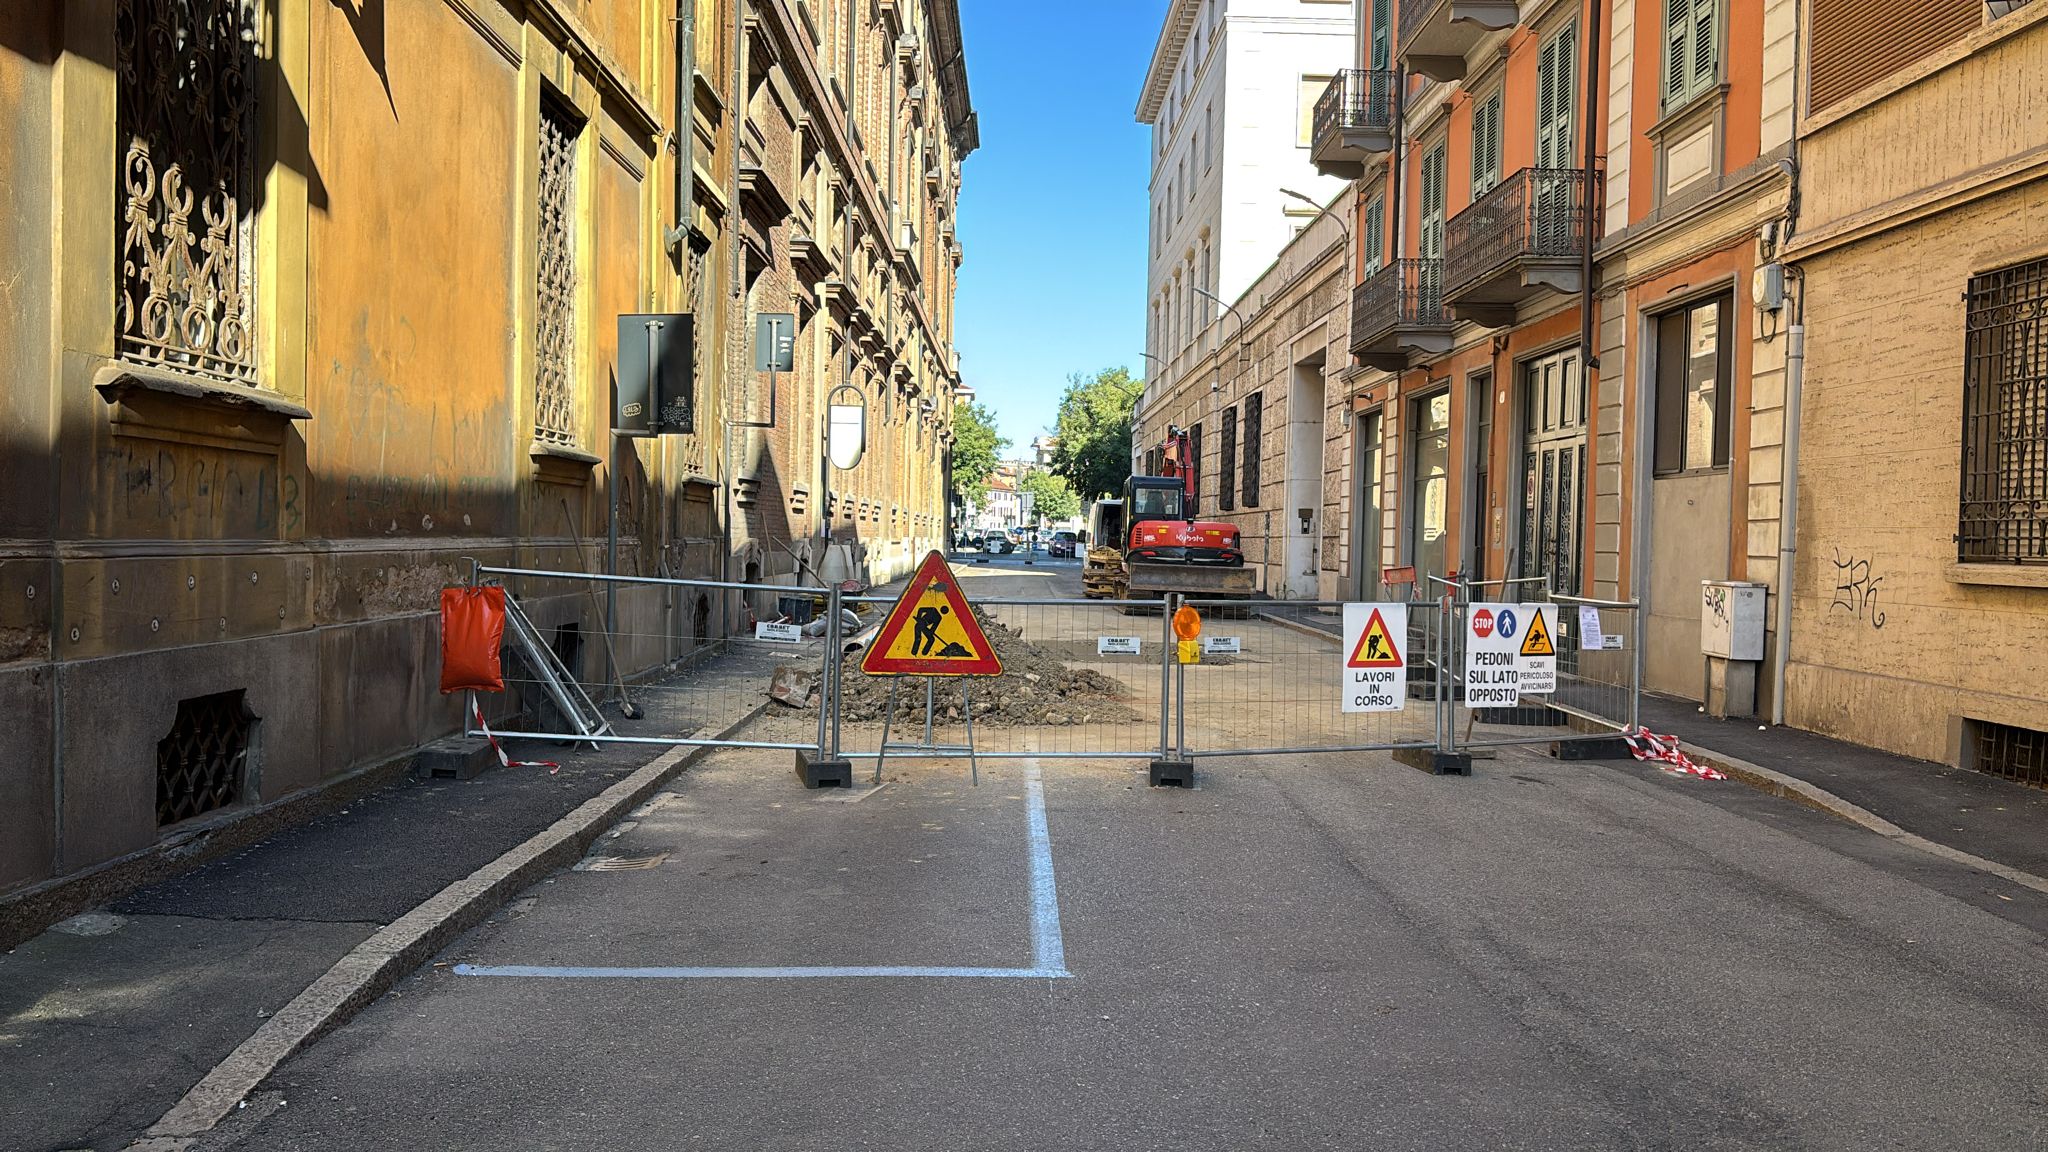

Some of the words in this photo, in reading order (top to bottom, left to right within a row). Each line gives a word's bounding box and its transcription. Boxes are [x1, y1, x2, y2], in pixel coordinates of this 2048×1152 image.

[1175, 534, 1204, 543] Kubota
[1474, 617, 1493, 629] STOP
[1475, 652, 1514, 666] PEDONI
[1529, 661, 1545, 669] SCAVI
[1355, 672, 1395, 683] LAVORI
[1469, 670, 1489, 684] SUL
[1492, 670, 1518, 684] LATO
[1520, 672, 1554, 680] PERICOLOSO
[1369, 683, 1380, 694] IN
[1520, 682, 1554, 691] AVVICINARSI
[1354, 695, 1393, 706] CORSO
[1469, 688, 1516, 702] OPPOSTO
